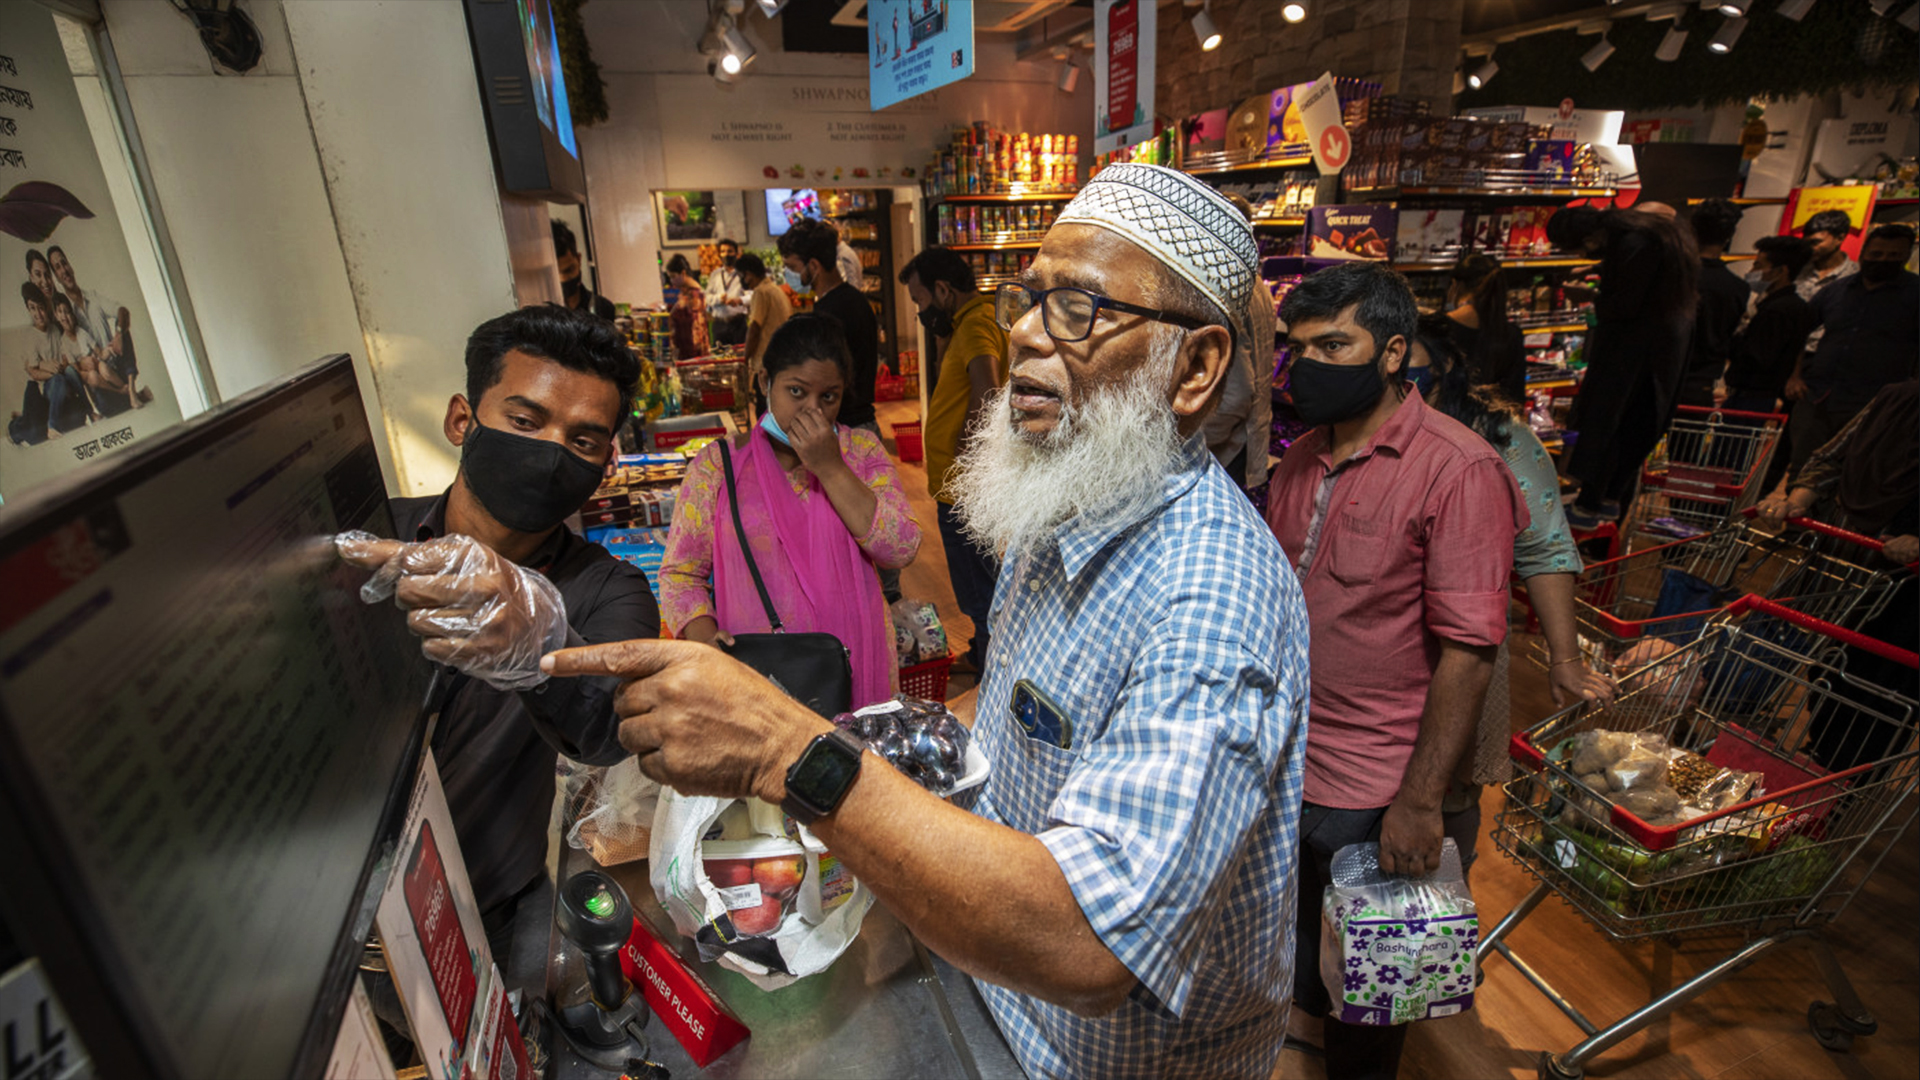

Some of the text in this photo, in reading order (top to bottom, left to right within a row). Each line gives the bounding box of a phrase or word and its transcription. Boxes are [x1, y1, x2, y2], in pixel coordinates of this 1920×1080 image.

[792, 87, 870, 100] SHWAPNO
[1301, 83, 1331, 112] CHOCOLATE
[730, 122, 773, 130] SHWAPNO
[711, 133, 792, 141] NOT ALWAYS RIGHT
[830, 133, 848, 142] NOT
[881, 133, 906, 142] RIGHT
[1327, 215, 1372, 227] QUICK TREAT
[72, 426, 134, 460] ভালো থাকবেন
[424, 879, 445, 943] 26969
[628, 944, 672, 1002] CUSTOMER
[671, 994, 705, 1041] PLEASE
[1395, 993, 1426, 1009] EXTRA
[1360, 1011, 1375, 1025] 4
